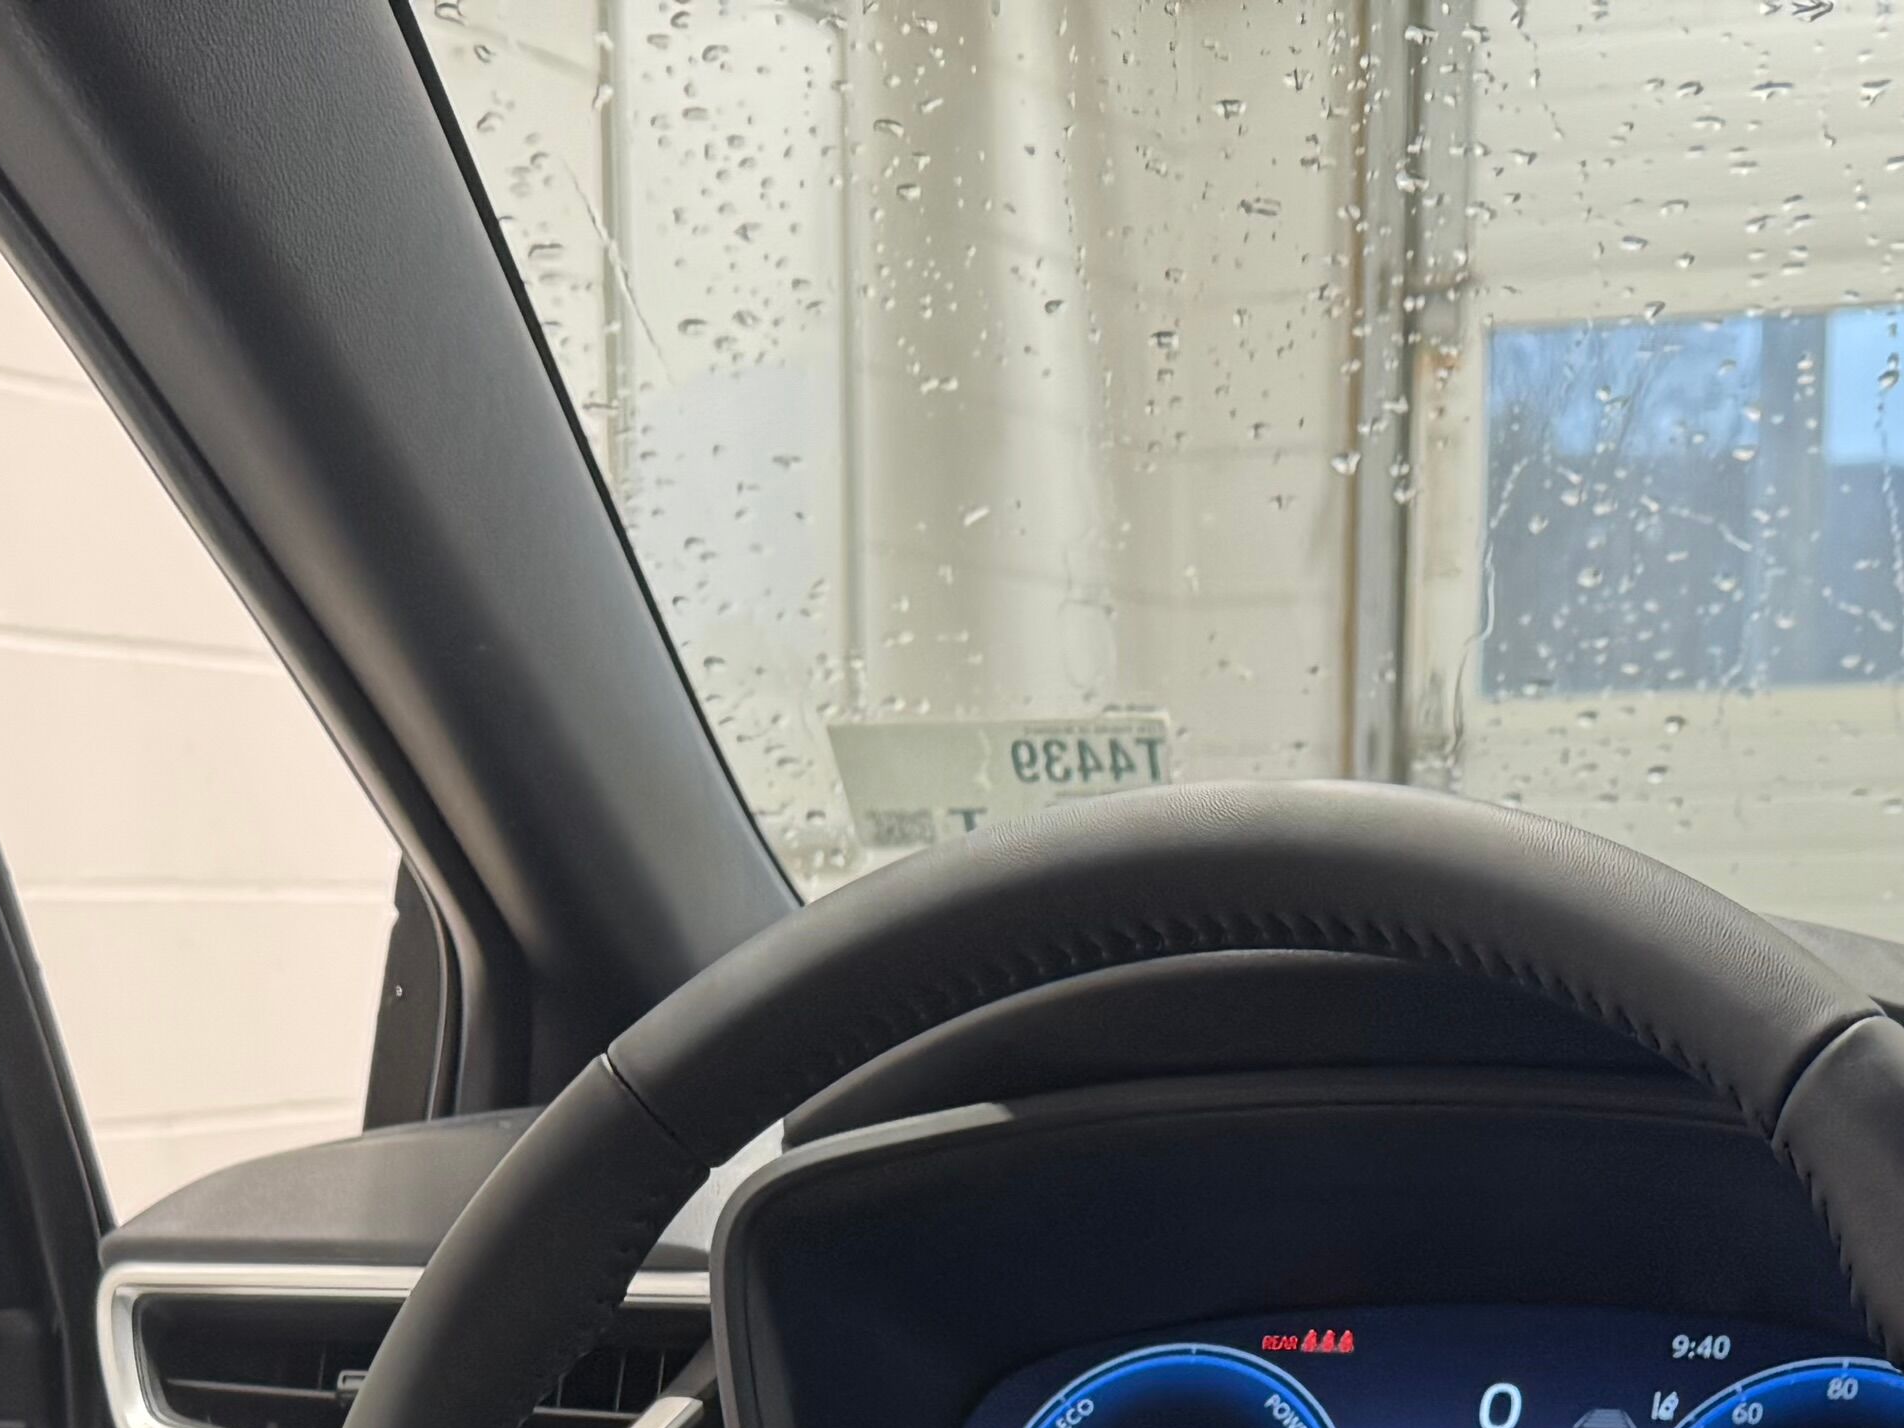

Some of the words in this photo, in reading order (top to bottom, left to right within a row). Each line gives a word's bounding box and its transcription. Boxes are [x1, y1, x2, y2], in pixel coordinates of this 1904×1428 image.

[1262, 1335, 1298, 1350] REAR
[1671, 1334, 1731, 1360] 9:40
[1826, 1377, 1859, 1400] 80
[1732, 1402, 1764, 1425] 60
